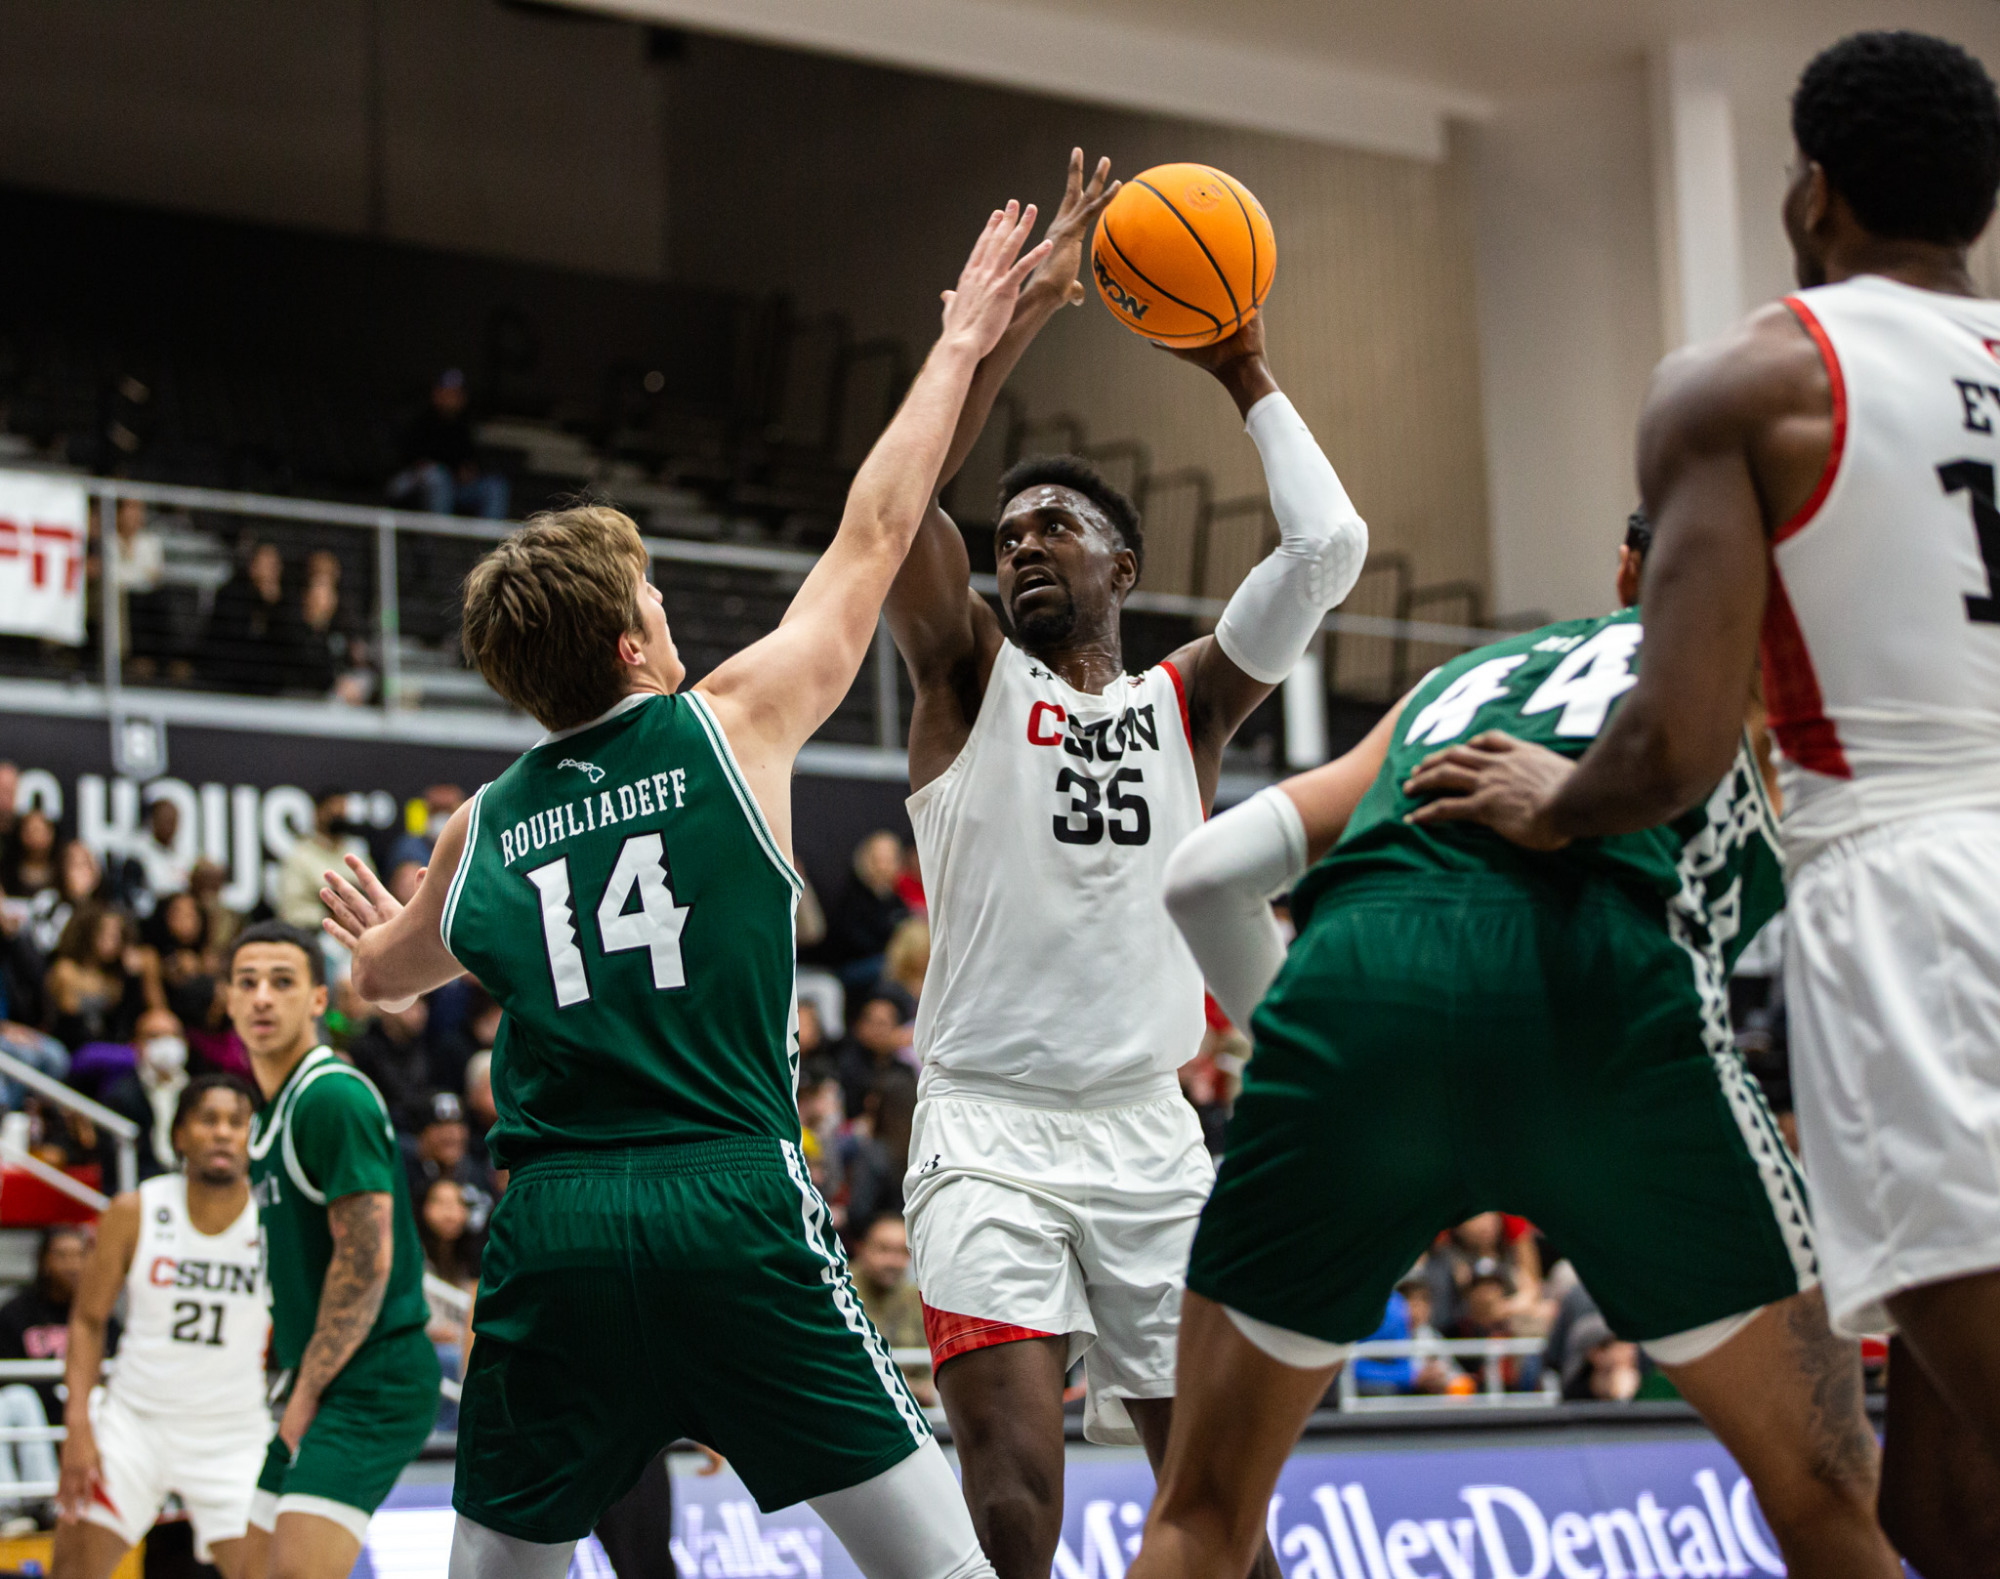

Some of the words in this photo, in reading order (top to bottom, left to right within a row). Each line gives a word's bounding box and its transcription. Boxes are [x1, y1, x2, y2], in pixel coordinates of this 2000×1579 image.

[1404, 622, 1645, 747] 44
[1026, 700, 1160, 763] CSUN
[77, 772, 367, 914] HOUS
[500, 767, 688, 868] ROUHLIADEFF
[1052, 767, 1151, 846] 35
[522, 829, 696, 1011] 14
[148, 1255, 262, 1295] CSUN
[172, 1300, 227, 1347] 21
